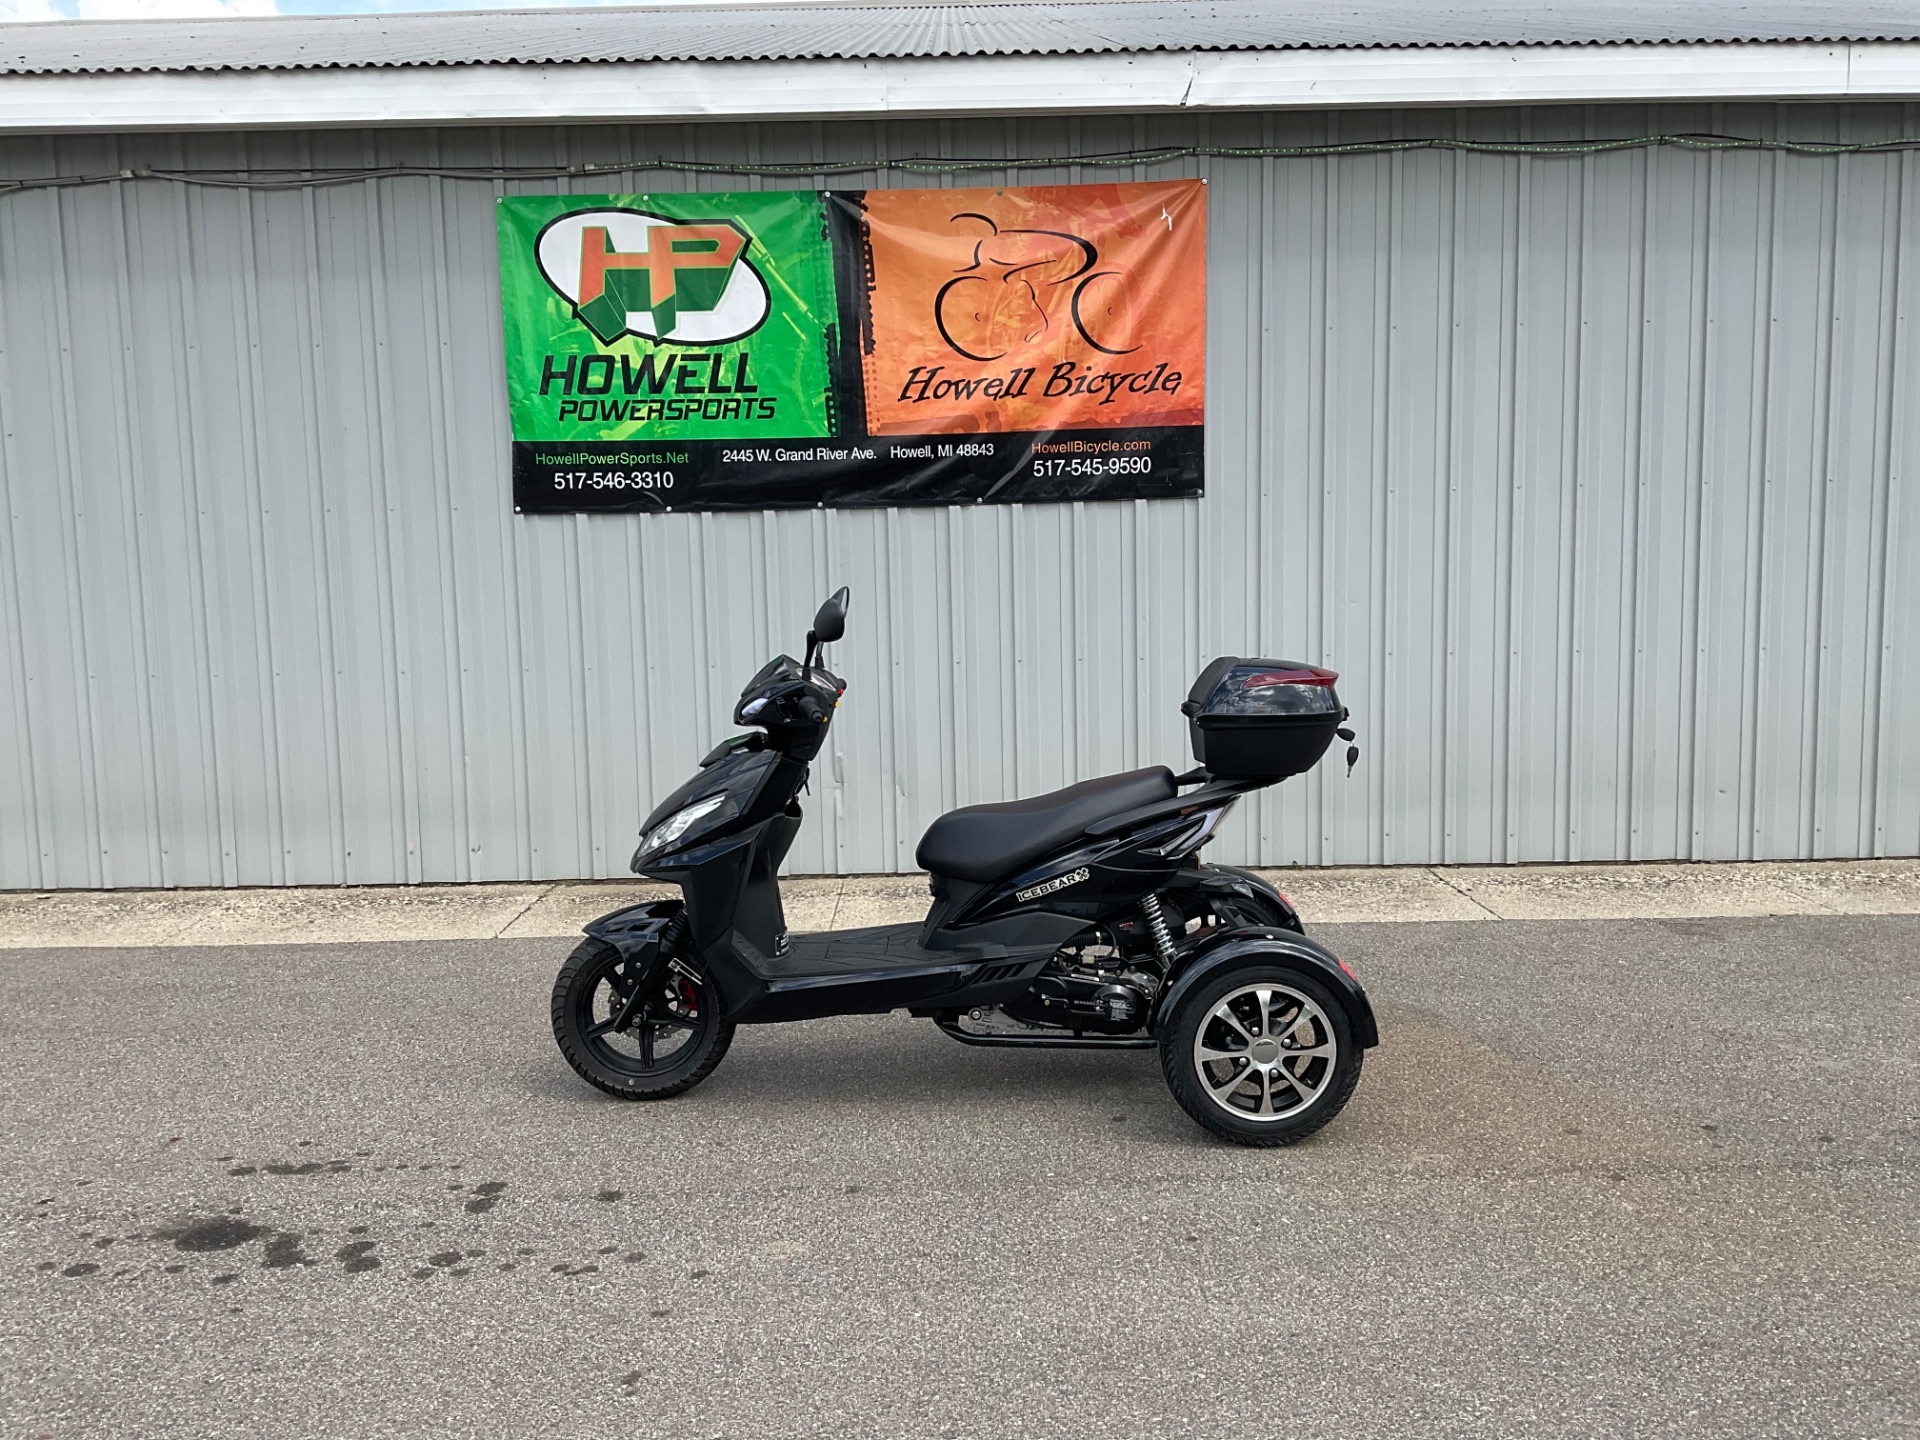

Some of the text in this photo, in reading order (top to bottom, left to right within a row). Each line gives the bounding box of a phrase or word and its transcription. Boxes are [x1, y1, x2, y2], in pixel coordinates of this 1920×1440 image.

[578, 224, 748, 332] HP
[539, 352, 758, 396] HOWELL
[897, 361, 1183, 405] Howell Bicycle
[558, 397, 777, 422] POWERSPORTS
[722, 443, 994, 462] 2445 W. Grand River Ave. Howell, MI 48843
[1031, 438, 1151, 455] HowellBicycle.com
[535, 451, 689, 467] HowellPowerSports.Net
[1033, 456, 1152, 477] 517-545-9590
[553, 470, 674, 490] 517-546-3310
[1017, 874, 1077, 902] ICEBEAR
